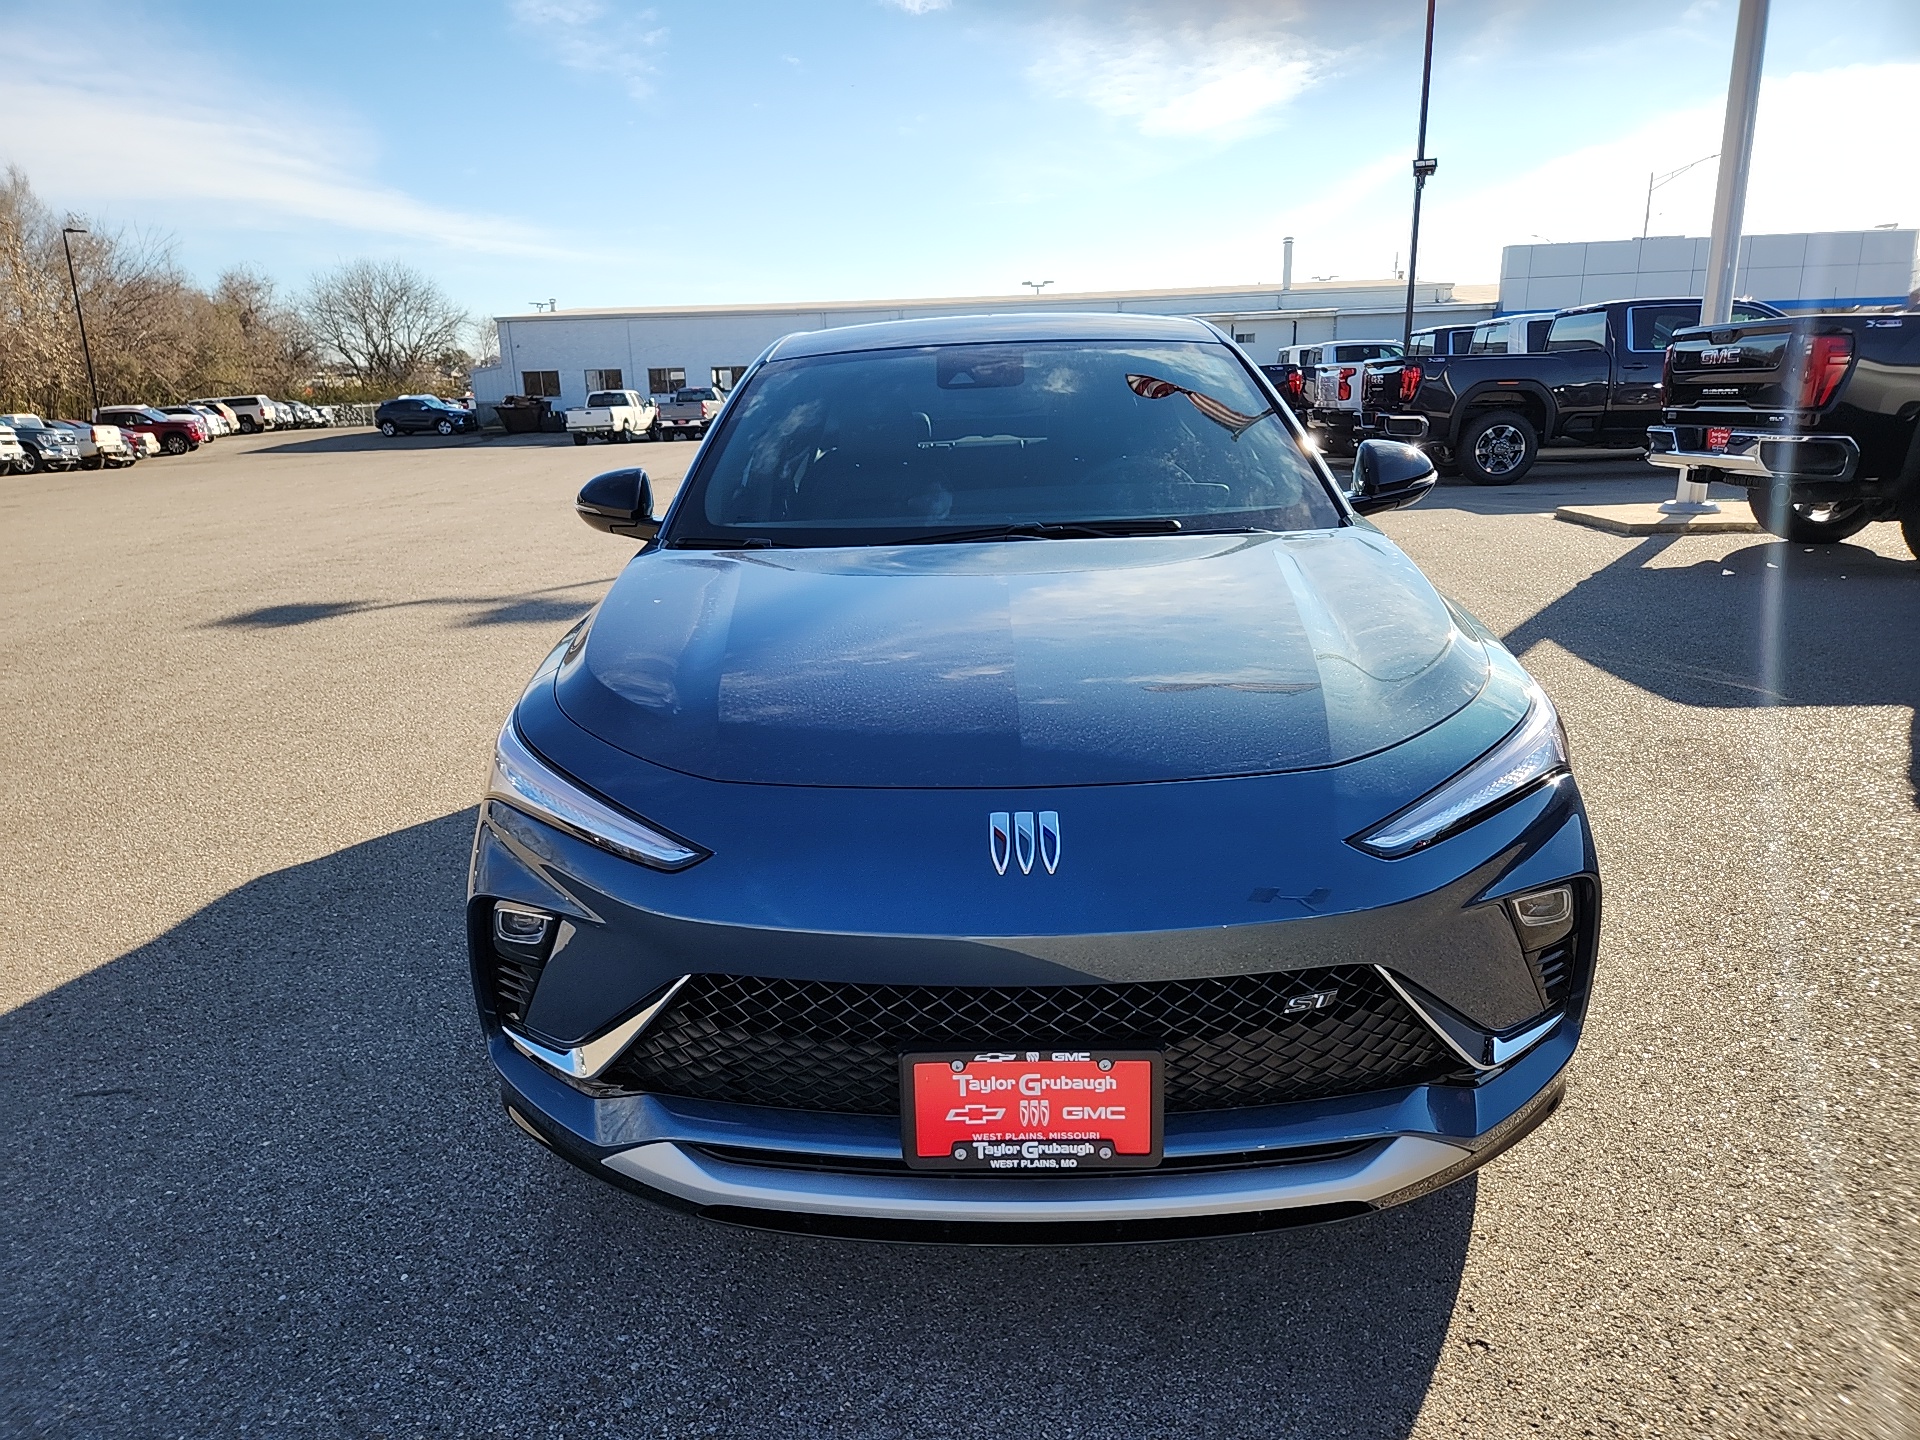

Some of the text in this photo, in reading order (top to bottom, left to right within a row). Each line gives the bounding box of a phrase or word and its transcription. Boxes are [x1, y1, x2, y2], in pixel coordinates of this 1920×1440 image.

[1701, 348, 1741, 365] GMC
[1283, 988, 1338, 1014] ST
[1051, 1052, 1091, 1062] GMC
[952, 1073, 1117, 1097] Taylor Grubaugh
[1062, 1106, 1126, 1120] GMC
[972, 1132, 1100, 1141] WEST PLAINS, MISSOURI
[972, 1141, 1095, 1160] Taylor Grubaugh
[990, 1159, 1078, 1169] WEST PLAINS, MO
